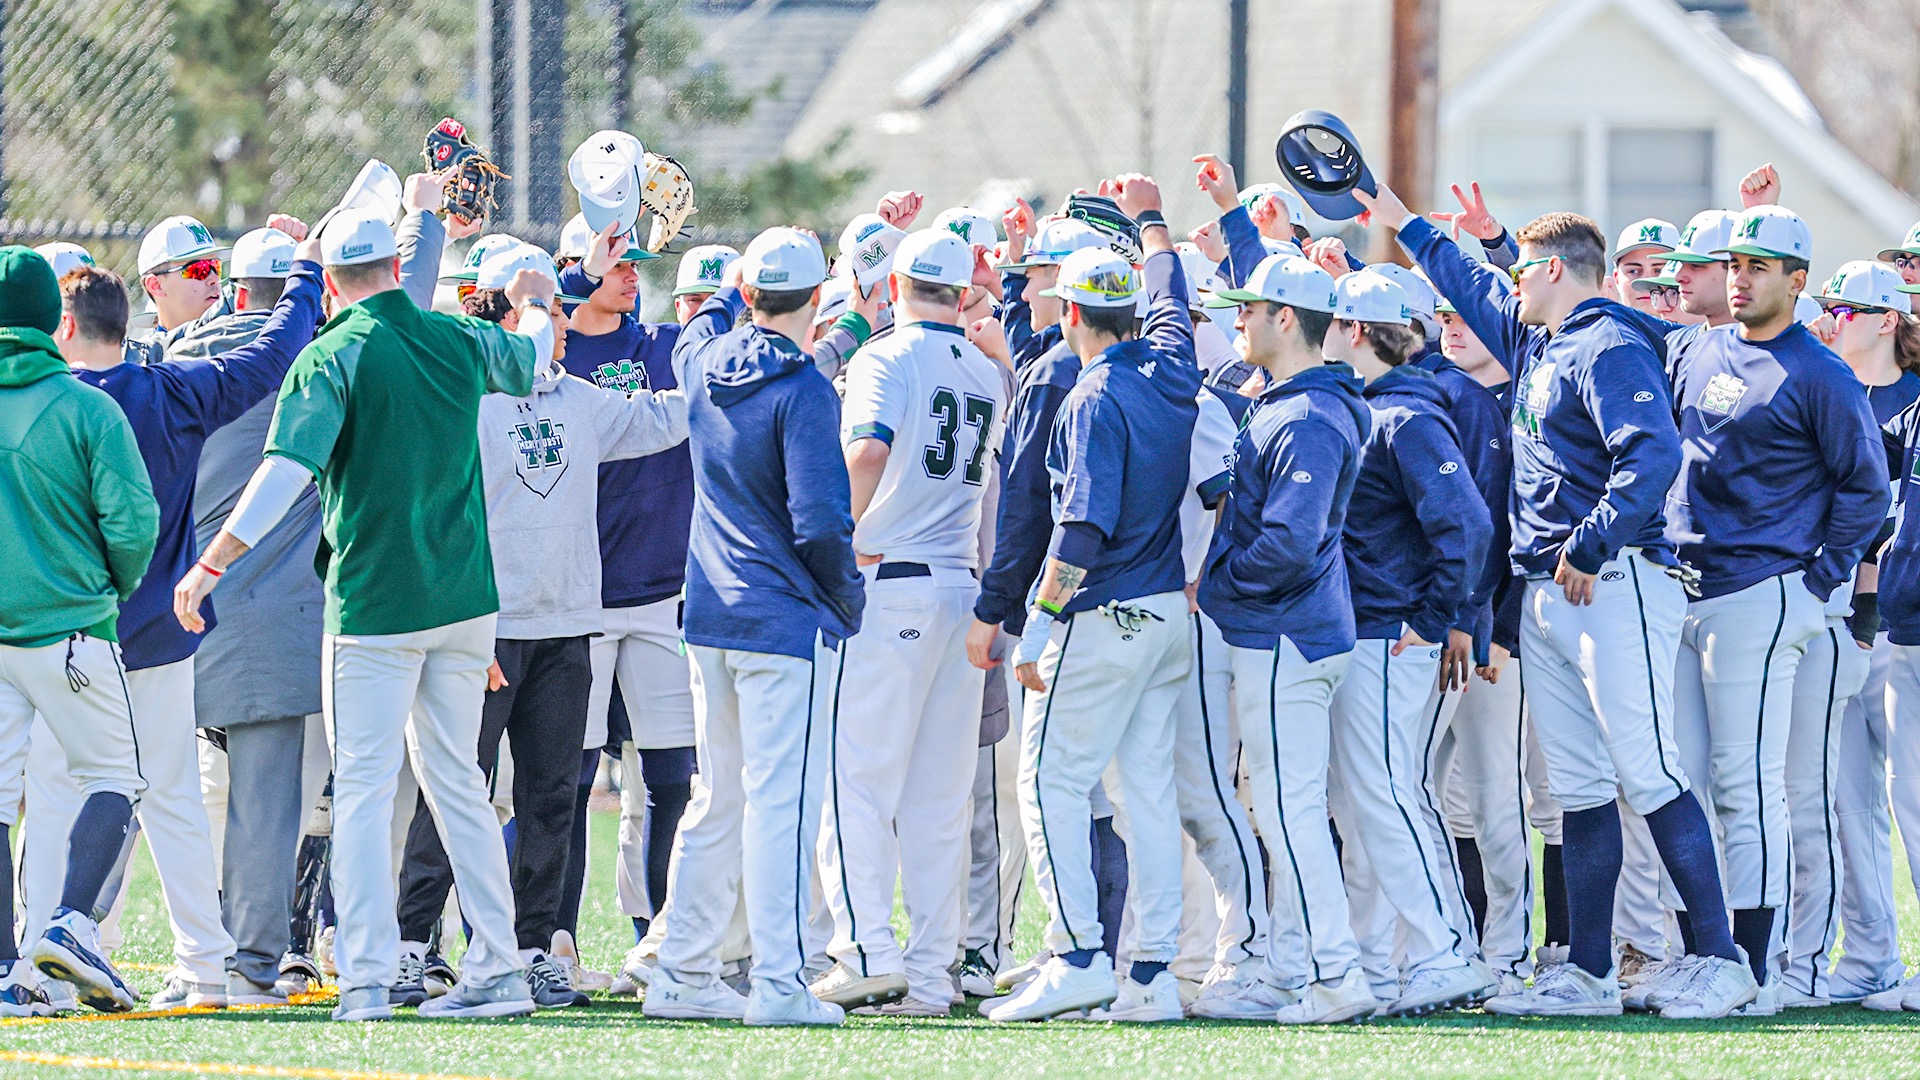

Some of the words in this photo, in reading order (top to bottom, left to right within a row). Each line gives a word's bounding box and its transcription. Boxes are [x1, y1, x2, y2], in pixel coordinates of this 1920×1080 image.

[187, 224, 214, 246] M
[1638, 224, 1663, 243] M
[1737, 216, 1765, 240] M
[859, 240, 890, 270] M
[697, 258, 725, 281] M
[518, 435, 562, 450] MERCURST
[921, 385, 997, 487] 37
